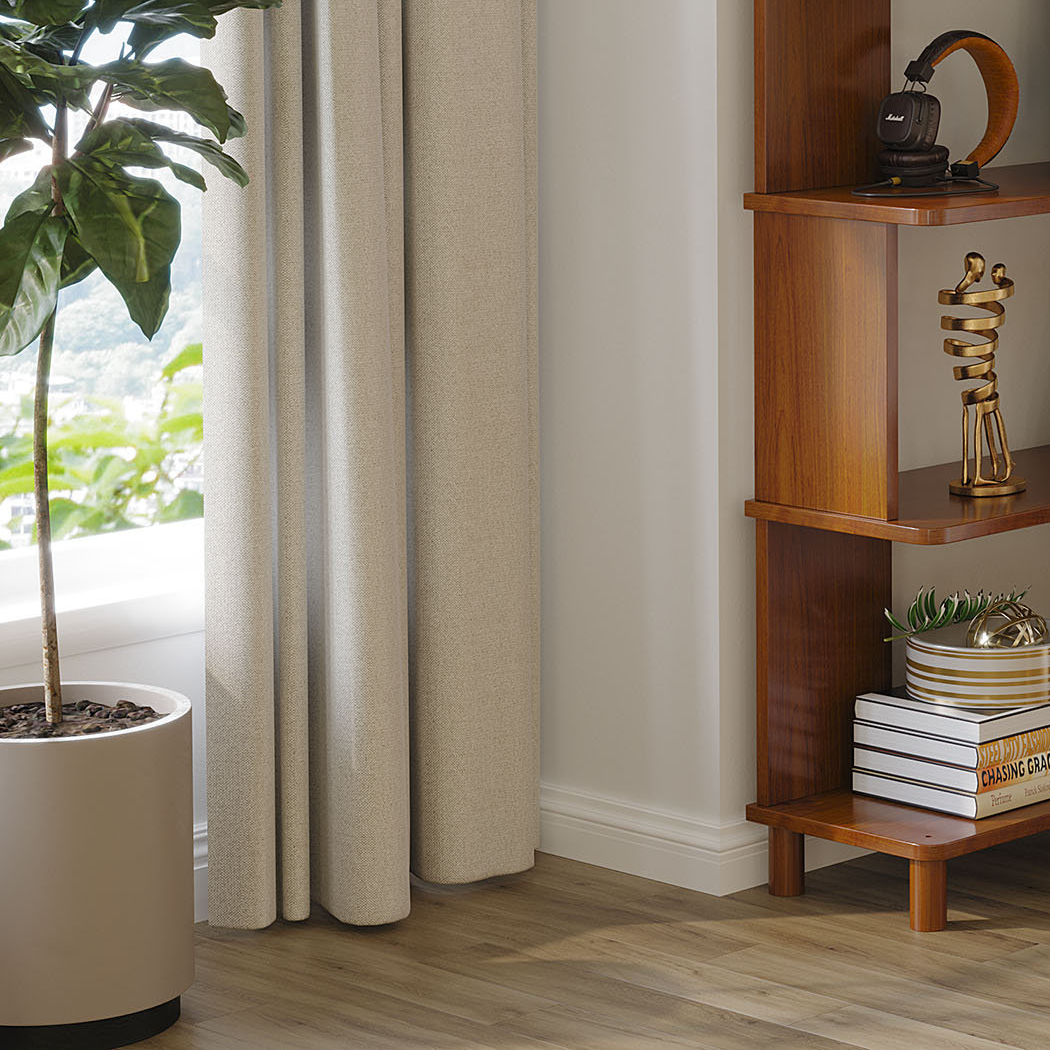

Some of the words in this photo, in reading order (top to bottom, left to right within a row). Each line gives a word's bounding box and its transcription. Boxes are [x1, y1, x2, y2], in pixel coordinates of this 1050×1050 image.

[979, 741, 1001, 766] STEEL
[1003, 734, 1021, 761] CITY
[981, 758, 1026, 787] CHASING
